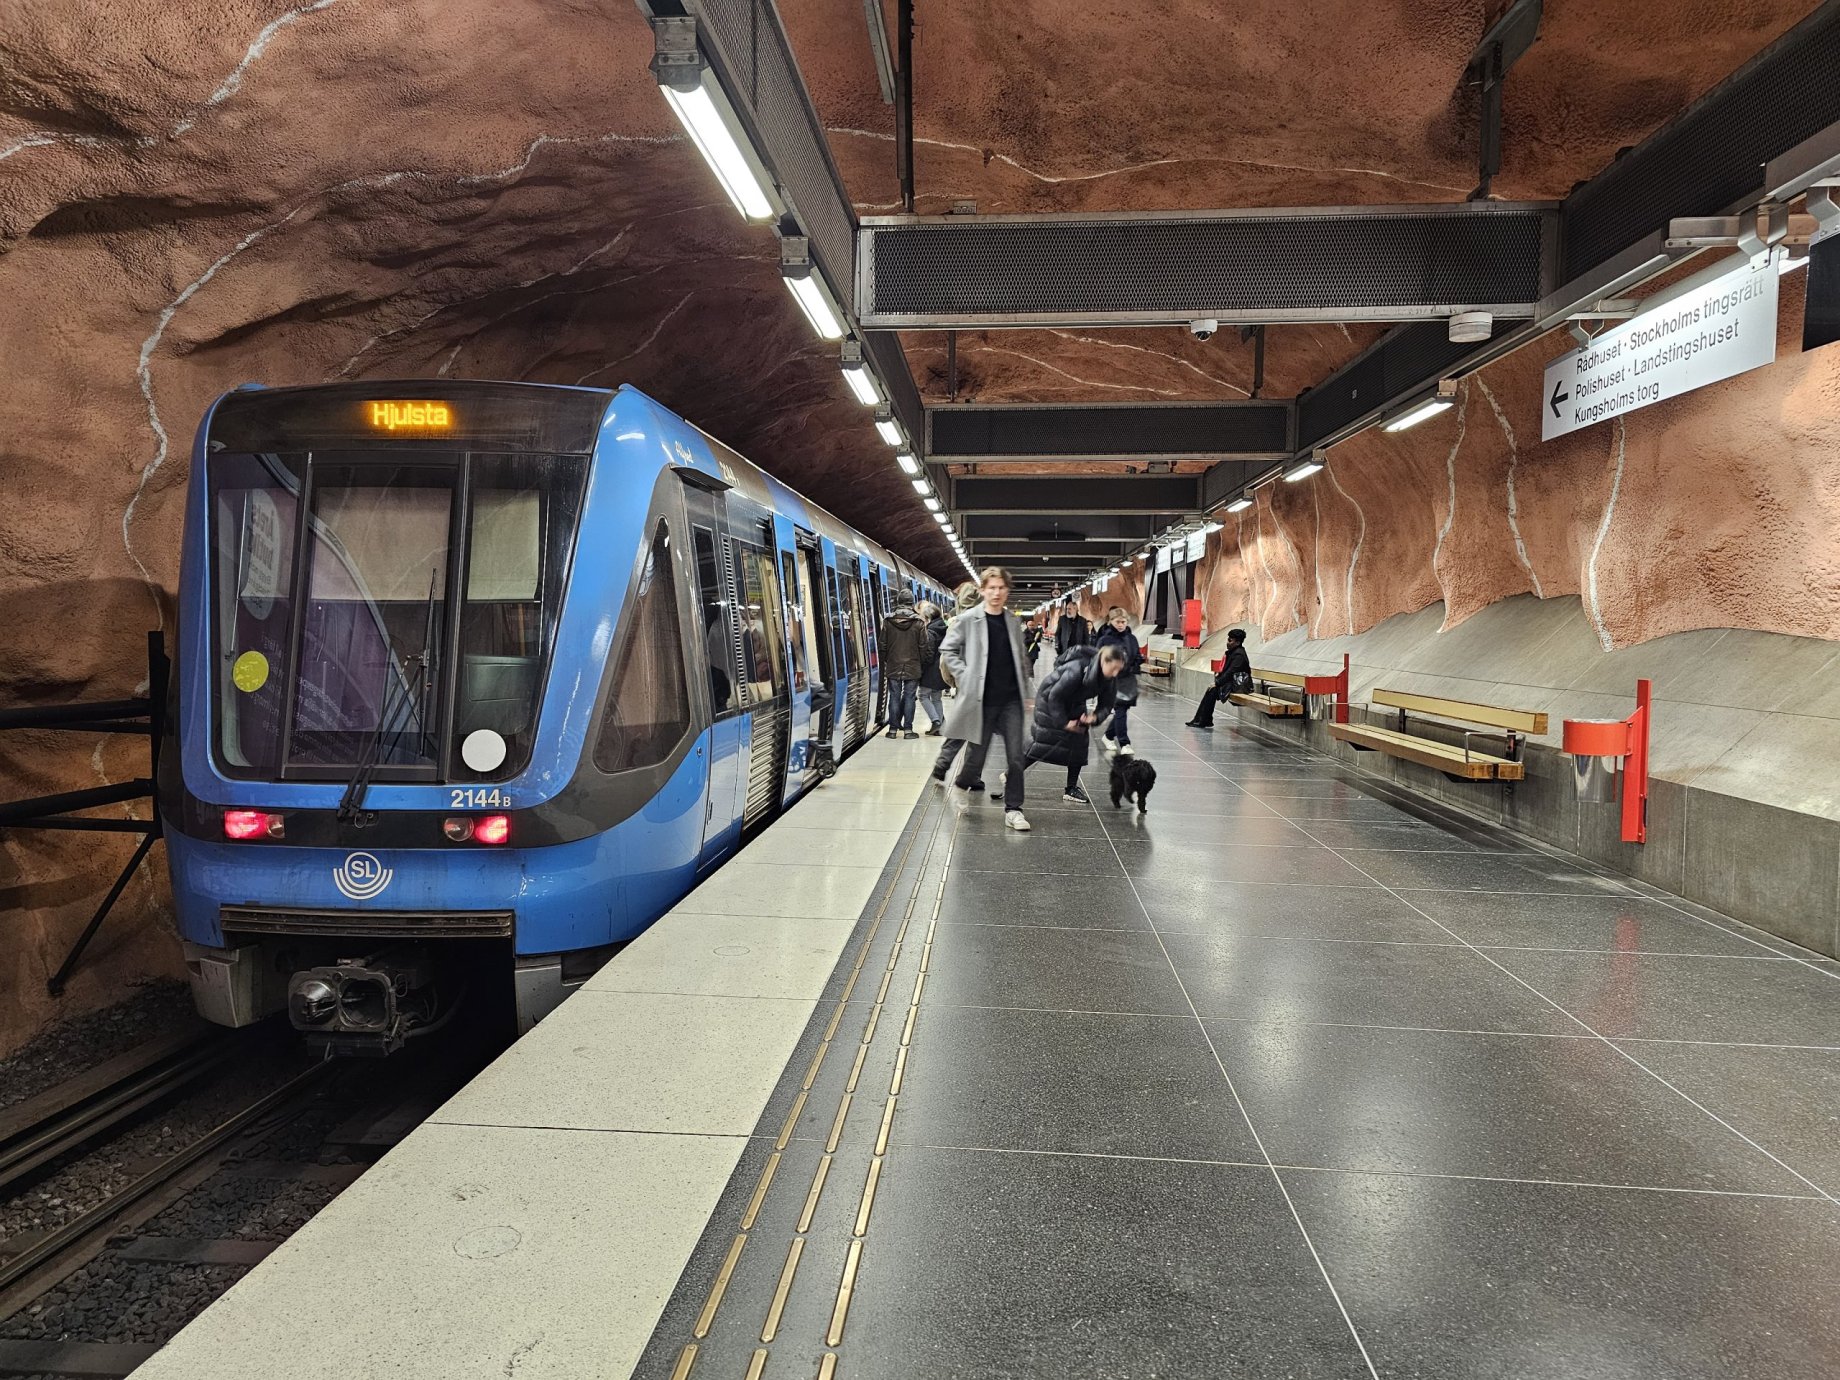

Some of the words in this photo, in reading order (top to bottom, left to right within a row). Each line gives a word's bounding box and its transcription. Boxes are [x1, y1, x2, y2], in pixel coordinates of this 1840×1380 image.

[1576, 340, 1621, 375] Rådhuset
[1630, 307, 1700, 350] Stockholms
[1704, 275, 1764, 318] tingsrätt
[1575, 365, 1625, 400] Polishuset
[1633, 318, 1739, 376] Landstingshuset
[373, 403, 448, 430] Hjulsta
[1575, 391, 1635, 424] Kungsholms
[1637, 381, 1659, 401] torg
[351, 860, 375, 878] SL
